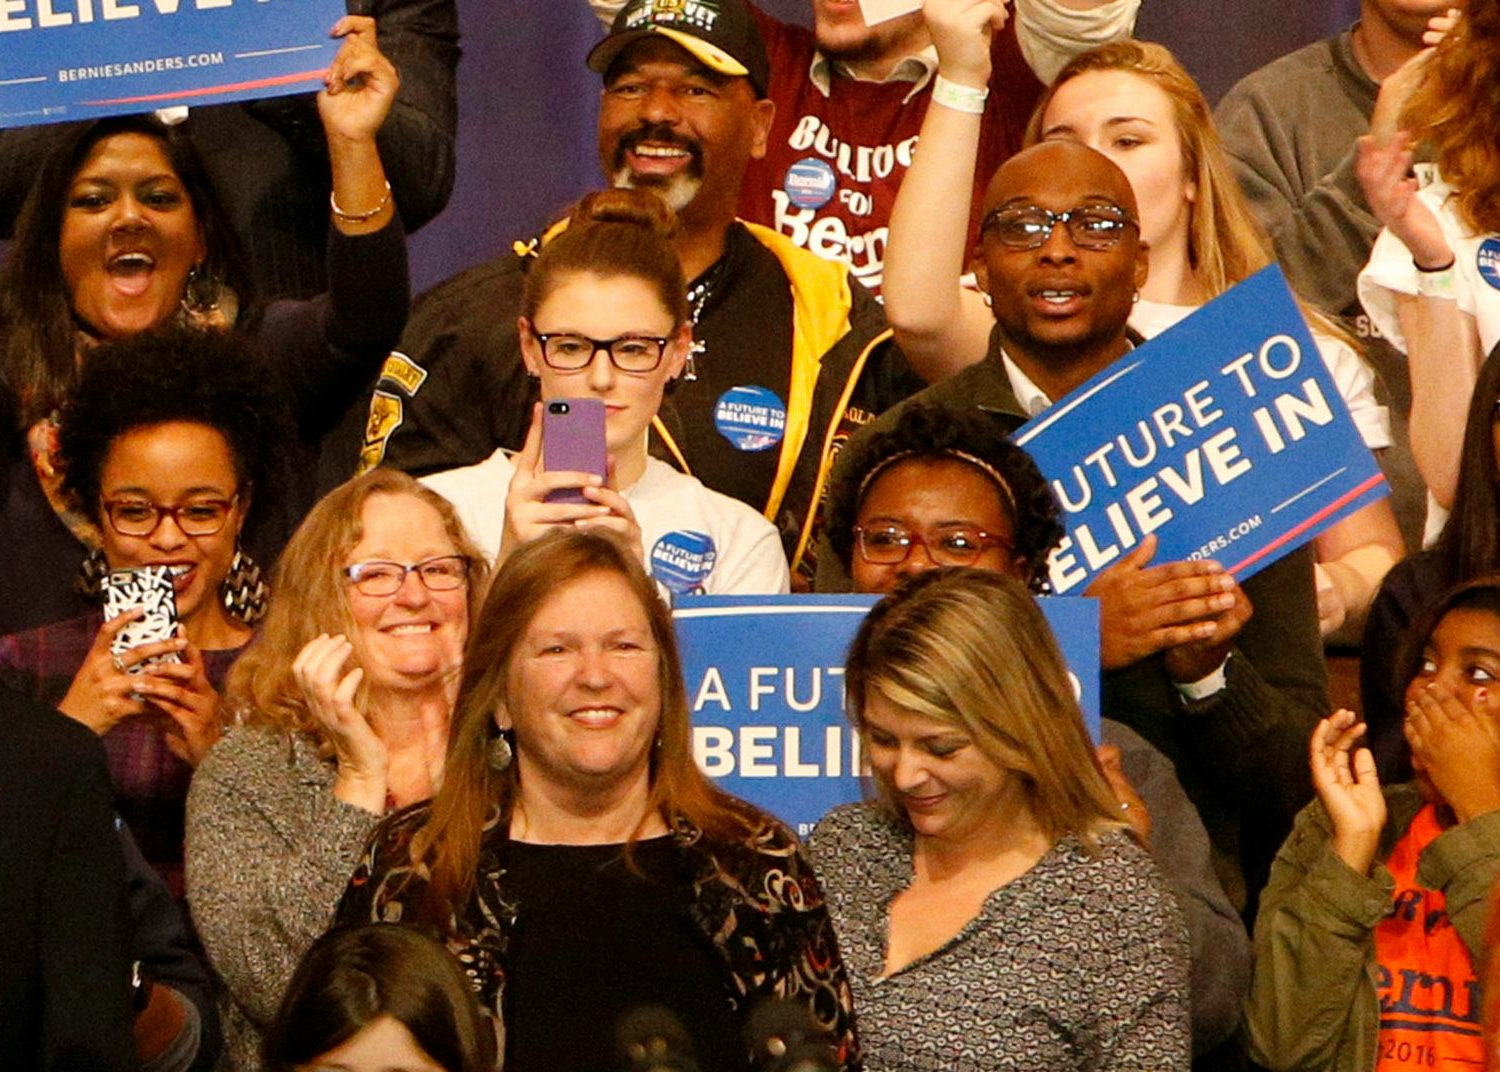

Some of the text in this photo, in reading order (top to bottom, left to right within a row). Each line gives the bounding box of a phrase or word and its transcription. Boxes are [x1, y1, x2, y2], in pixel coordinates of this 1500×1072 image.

[58, 52, 224, 83] BERNIESANDERS.COM
[716, 409, 785, 430] BELIEVE IN
[727, 402, 768, 415] FUTURE
[770, 407, 785, 419] TO
[1052, 334, 1301, 514] UTURE TO
[1045, 378, 1334, 594] ELIEVE IN
[653, 549, 701, 573] BELIEVE
[693, 667, 732, 712] A
[692, 726, 873, 778] BELI
[1380, 1038, 1436, 1067] 2016
